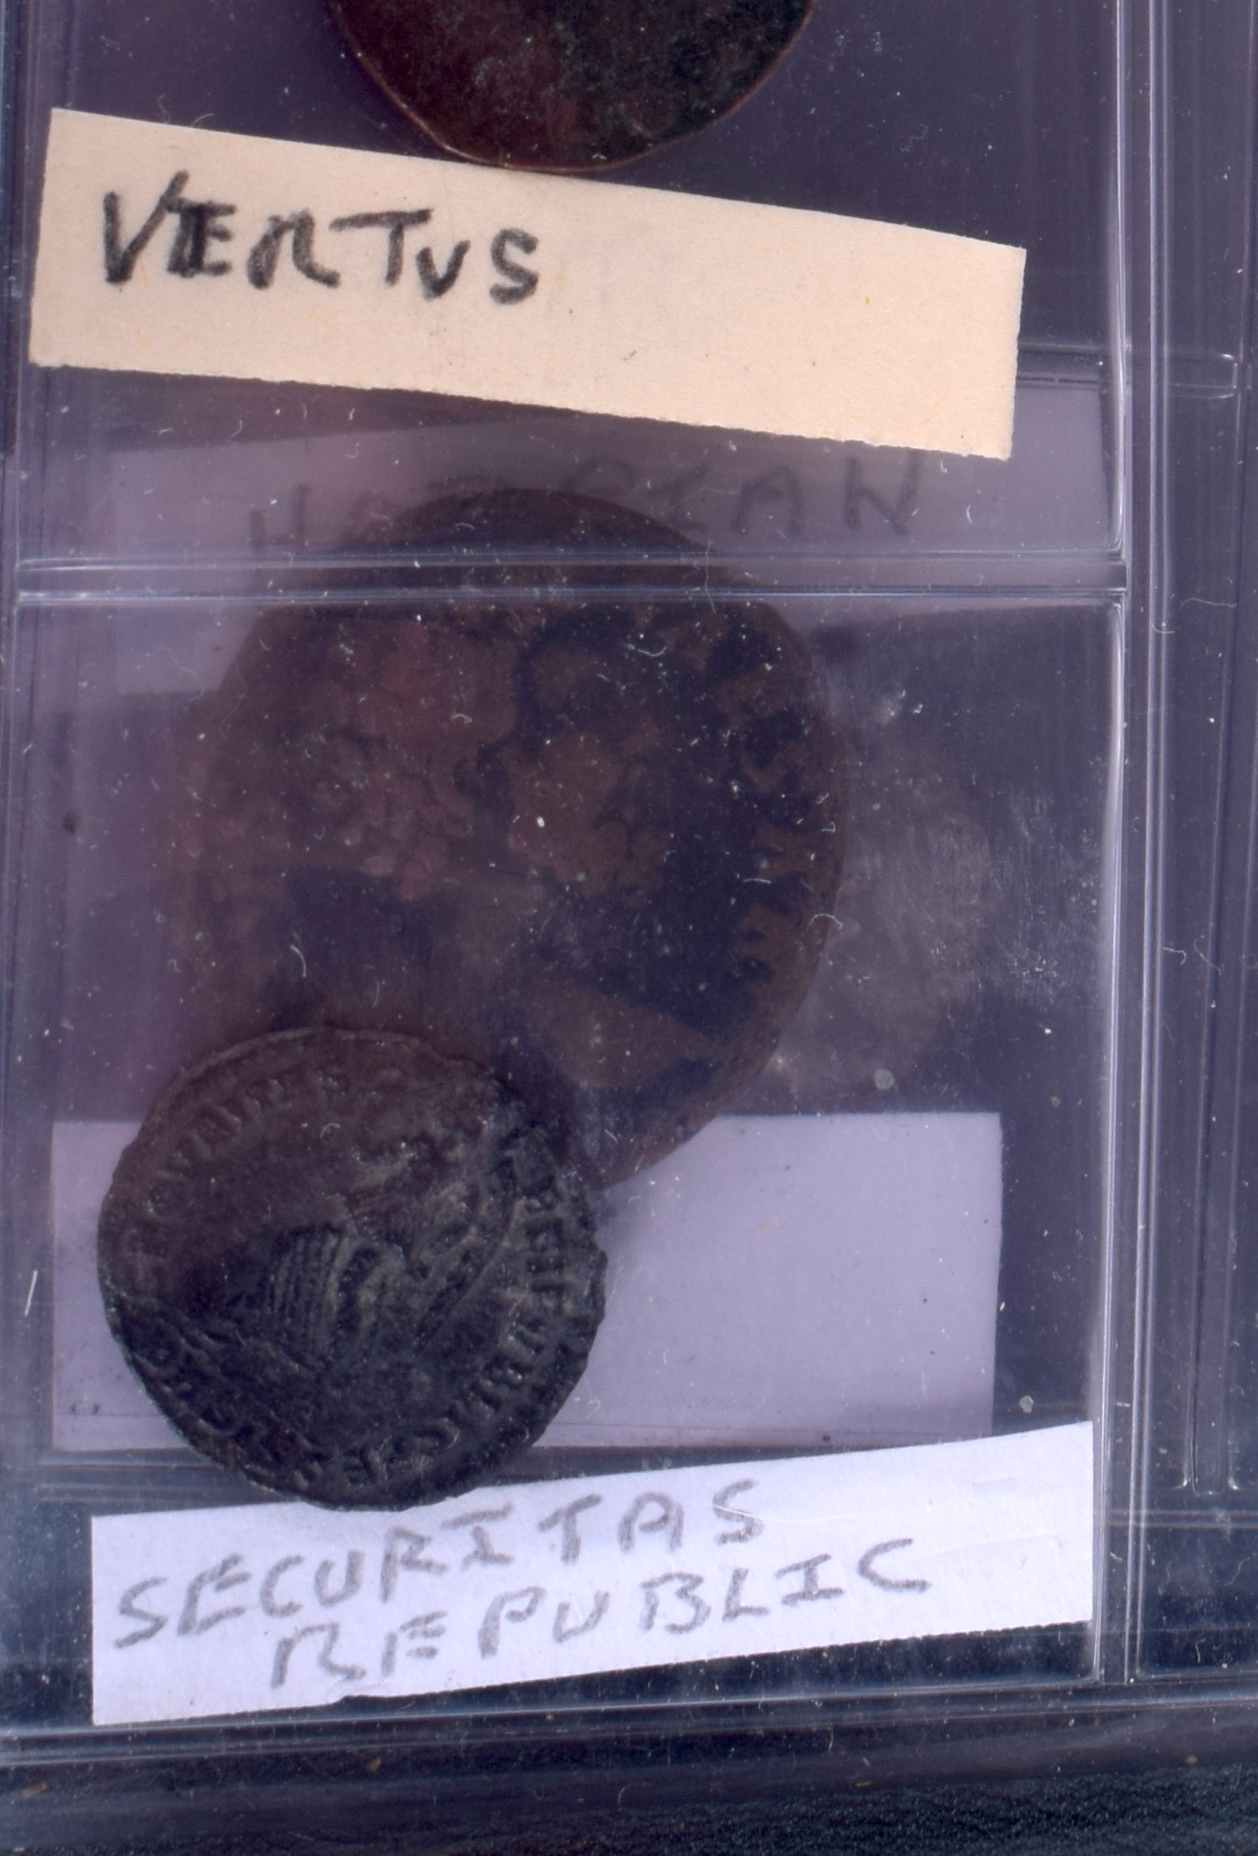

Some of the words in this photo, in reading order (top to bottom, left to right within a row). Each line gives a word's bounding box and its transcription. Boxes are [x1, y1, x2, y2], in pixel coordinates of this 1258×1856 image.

[249, 446, 922, 550] HARIAN
[115, 1478, 765, 1650] SECURITAS
[270, 1537, 932, 1699] REPUBLIC
